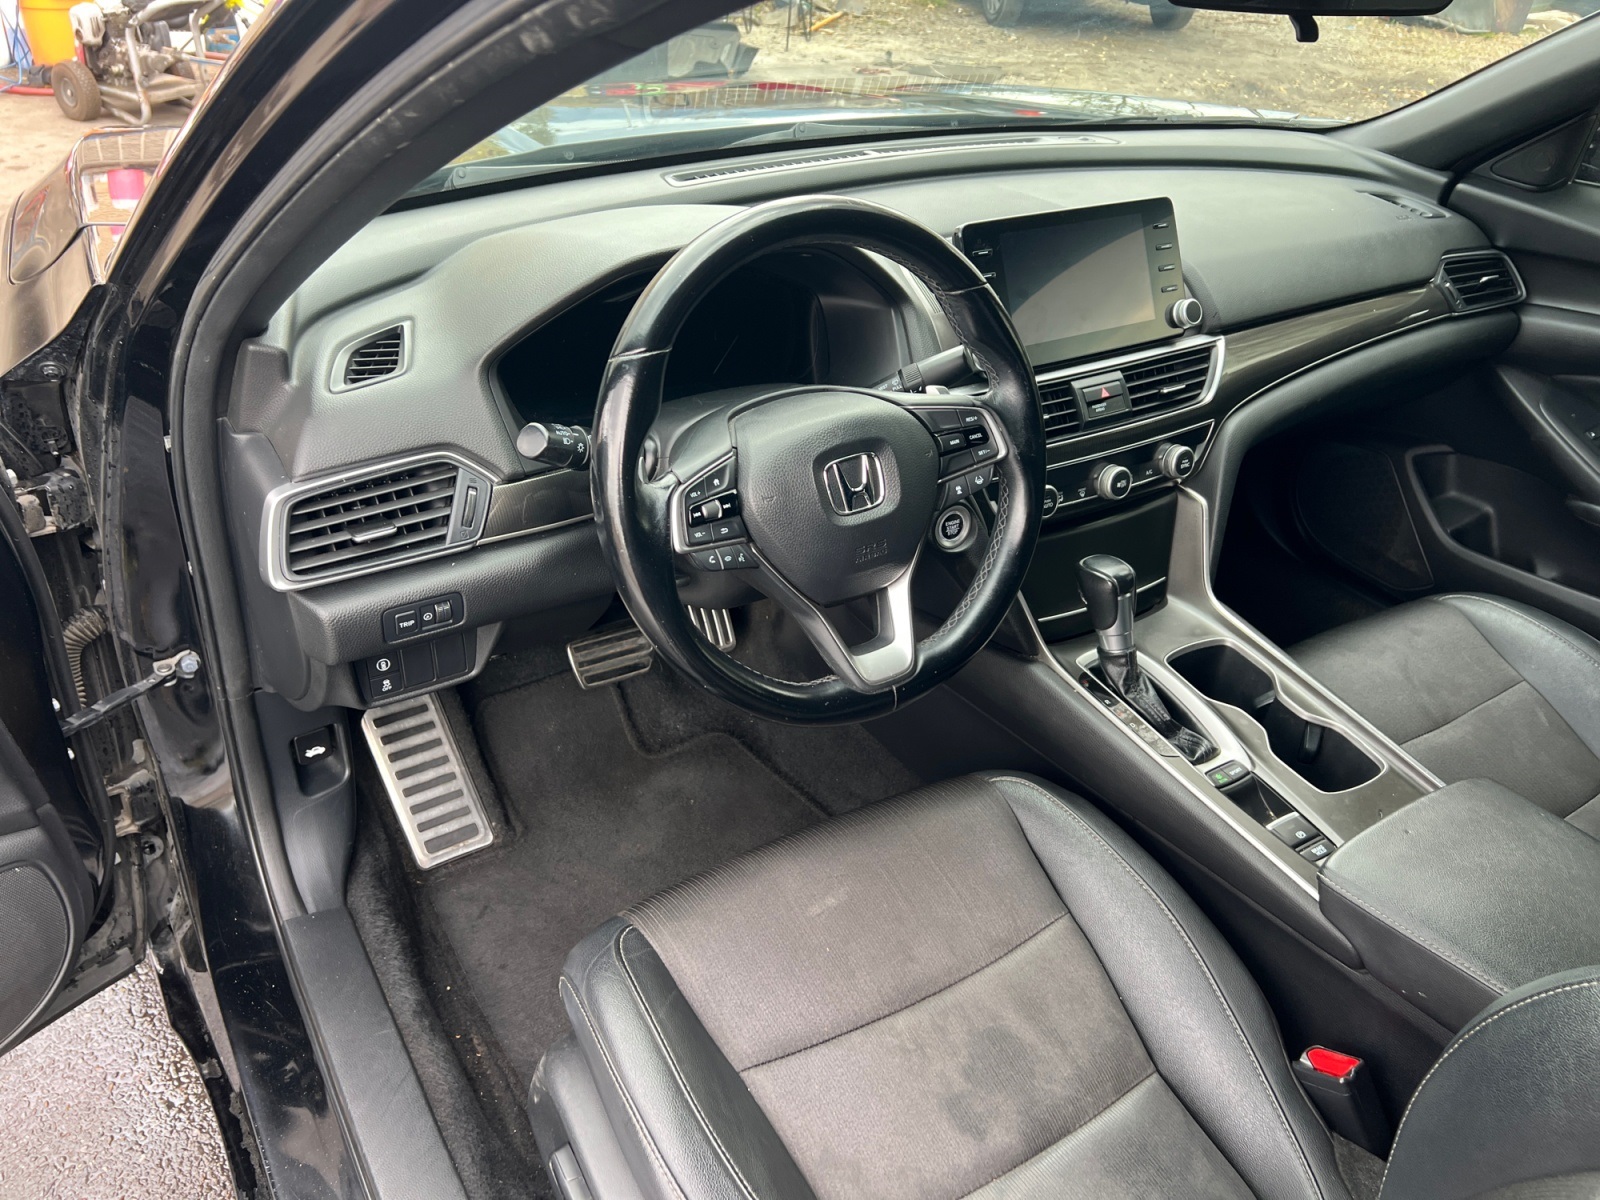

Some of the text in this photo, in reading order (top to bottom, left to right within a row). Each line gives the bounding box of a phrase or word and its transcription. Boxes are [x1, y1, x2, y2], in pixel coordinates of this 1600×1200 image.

[969, 432, 983, 440] CANCEL
[949, 438, 960, 446] MAIN
[945, 518, 960, 526] ENGINE
[399, 619, 415, 629] TRIP
